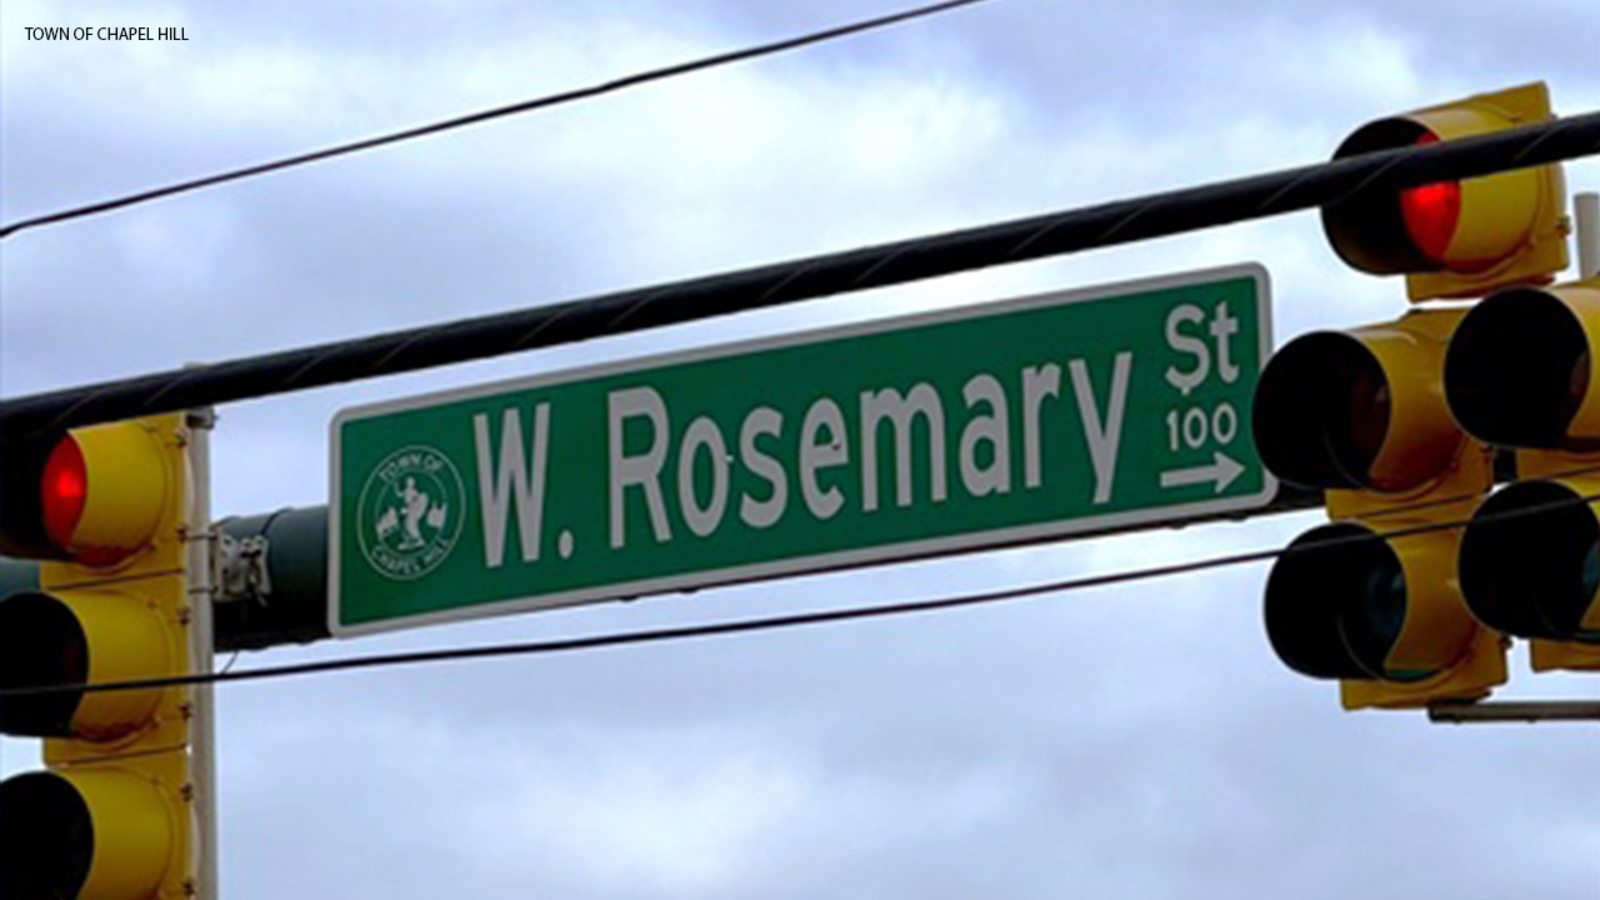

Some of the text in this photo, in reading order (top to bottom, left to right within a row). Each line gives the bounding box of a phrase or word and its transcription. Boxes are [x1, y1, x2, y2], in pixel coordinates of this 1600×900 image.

[473, 301, 1239, 568] W. Rosemary St
[1166, 402, 1238, 451] 100
[379, 453, 445, 483] TOWN OF
[371, 538, 450, 575] CHAPEL HILL
